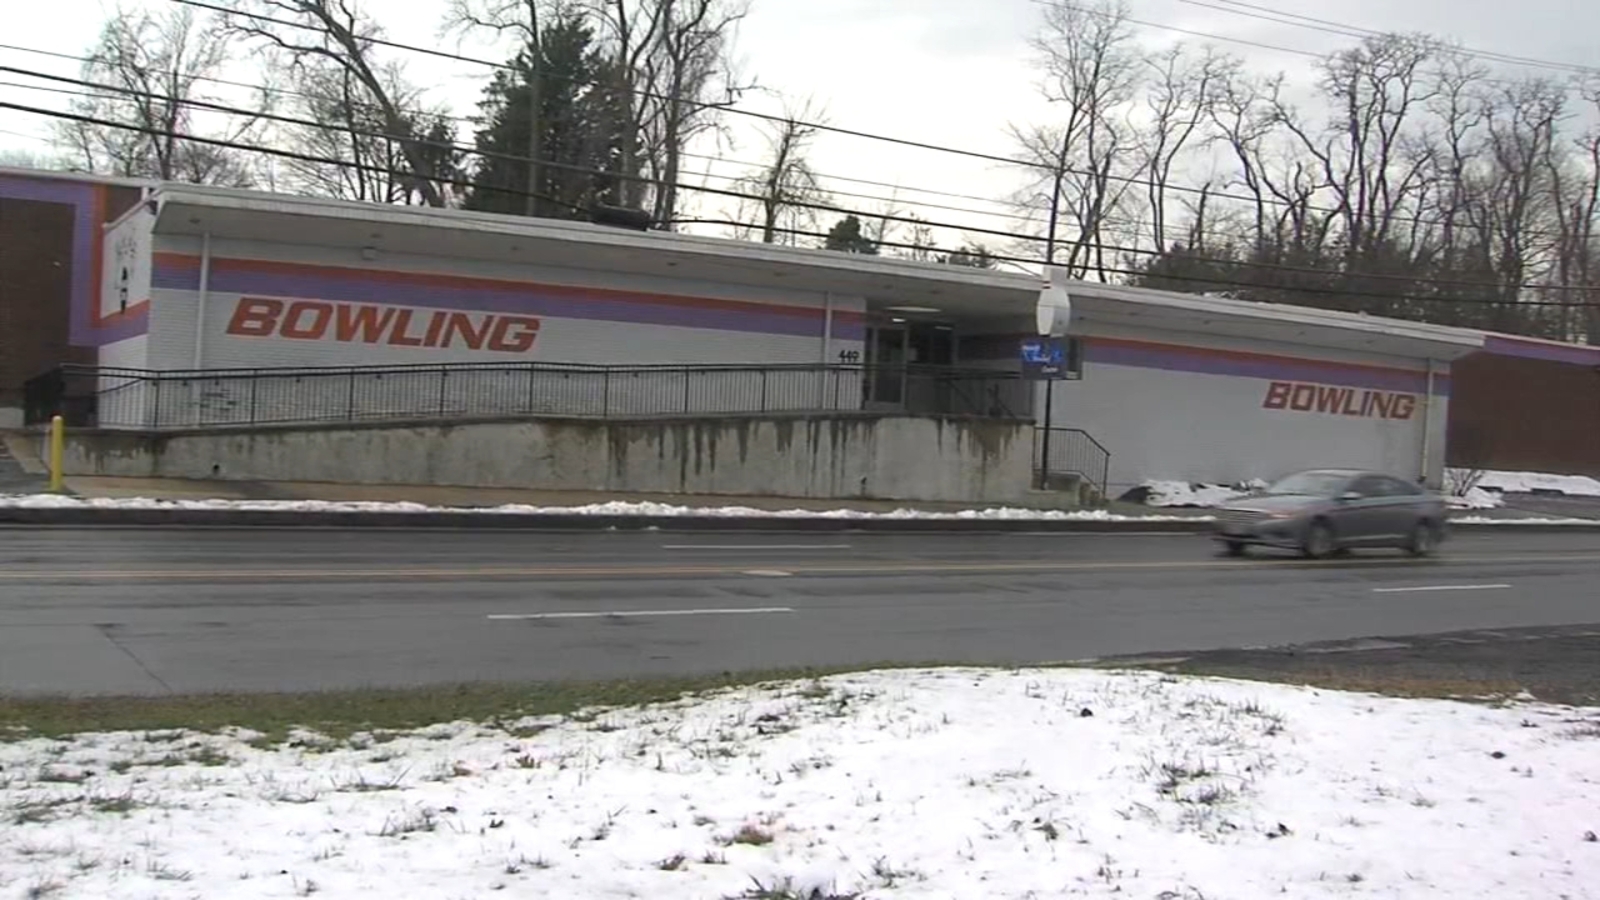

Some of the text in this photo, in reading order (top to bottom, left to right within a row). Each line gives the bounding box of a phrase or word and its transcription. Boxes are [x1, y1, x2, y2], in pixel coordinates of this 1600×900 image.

[226, 296, 541, 353] BOWLING
[838, 350, 860, 363] 449
[1262, 381, 1416, 420] BOWLING
